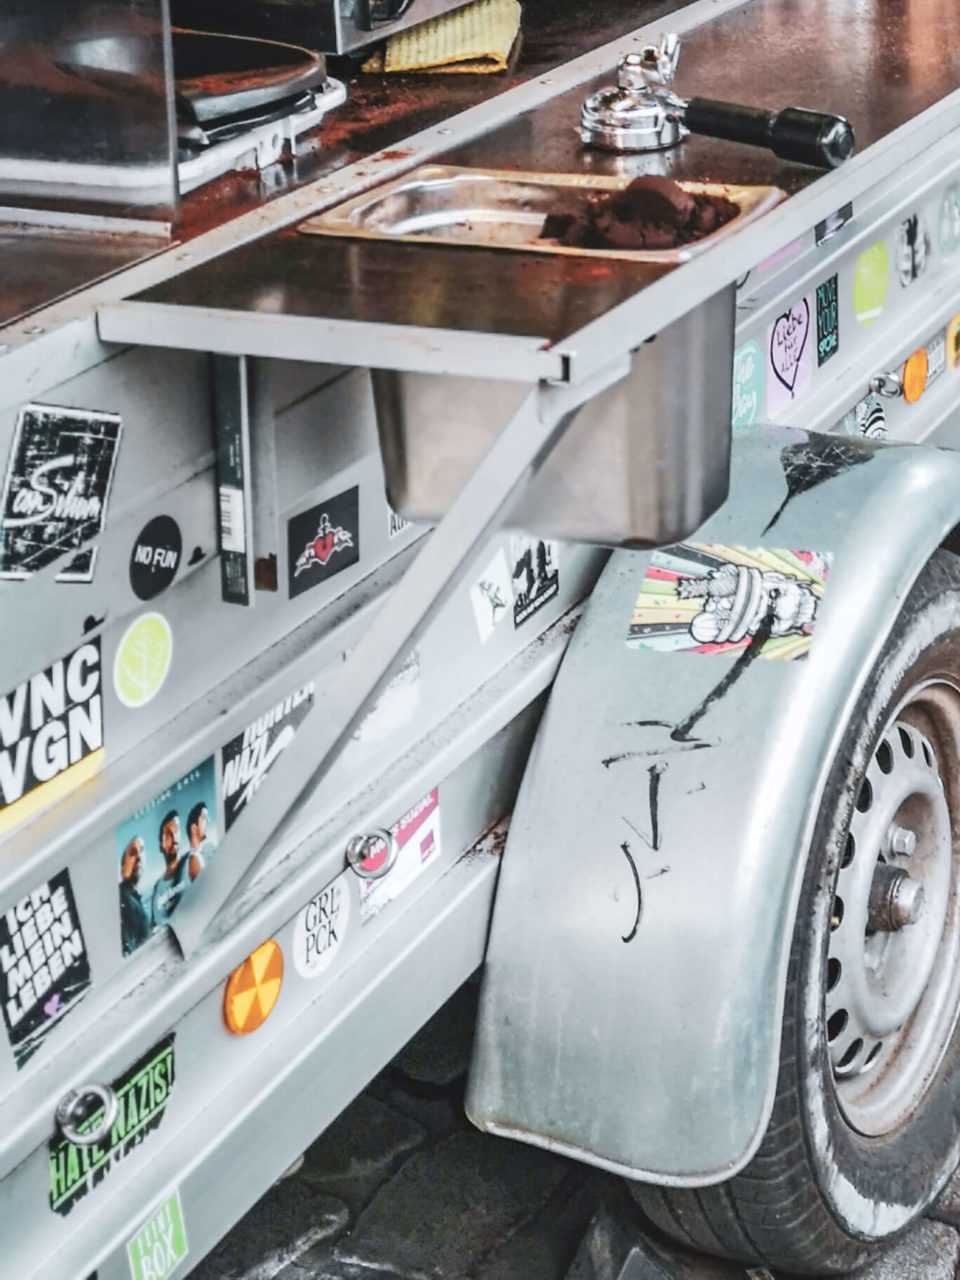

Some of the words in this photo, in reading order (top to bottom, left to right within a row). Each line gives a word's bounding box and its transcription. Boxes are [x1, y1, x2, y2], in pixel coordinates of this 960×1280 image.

[134, 545, 152, 565] NO
[153, 547, 178, 569] FUN
[0, 644, 100, 748] VNC
[0, 694, 102, 805] VGN
[0, 886, 69, 974] LIEBE
[6, 881, 50, 936] ICH
[304, 887, 341, 933] GRL
[305, 918, 339, 965] PCK
[6, 928, 84, 1028] LEBEN
[7, 910, 74, 998] MEIN
[111, 1053, 173, 1147] NAZIS!
[141, 1223, 178, 1280] BOX
